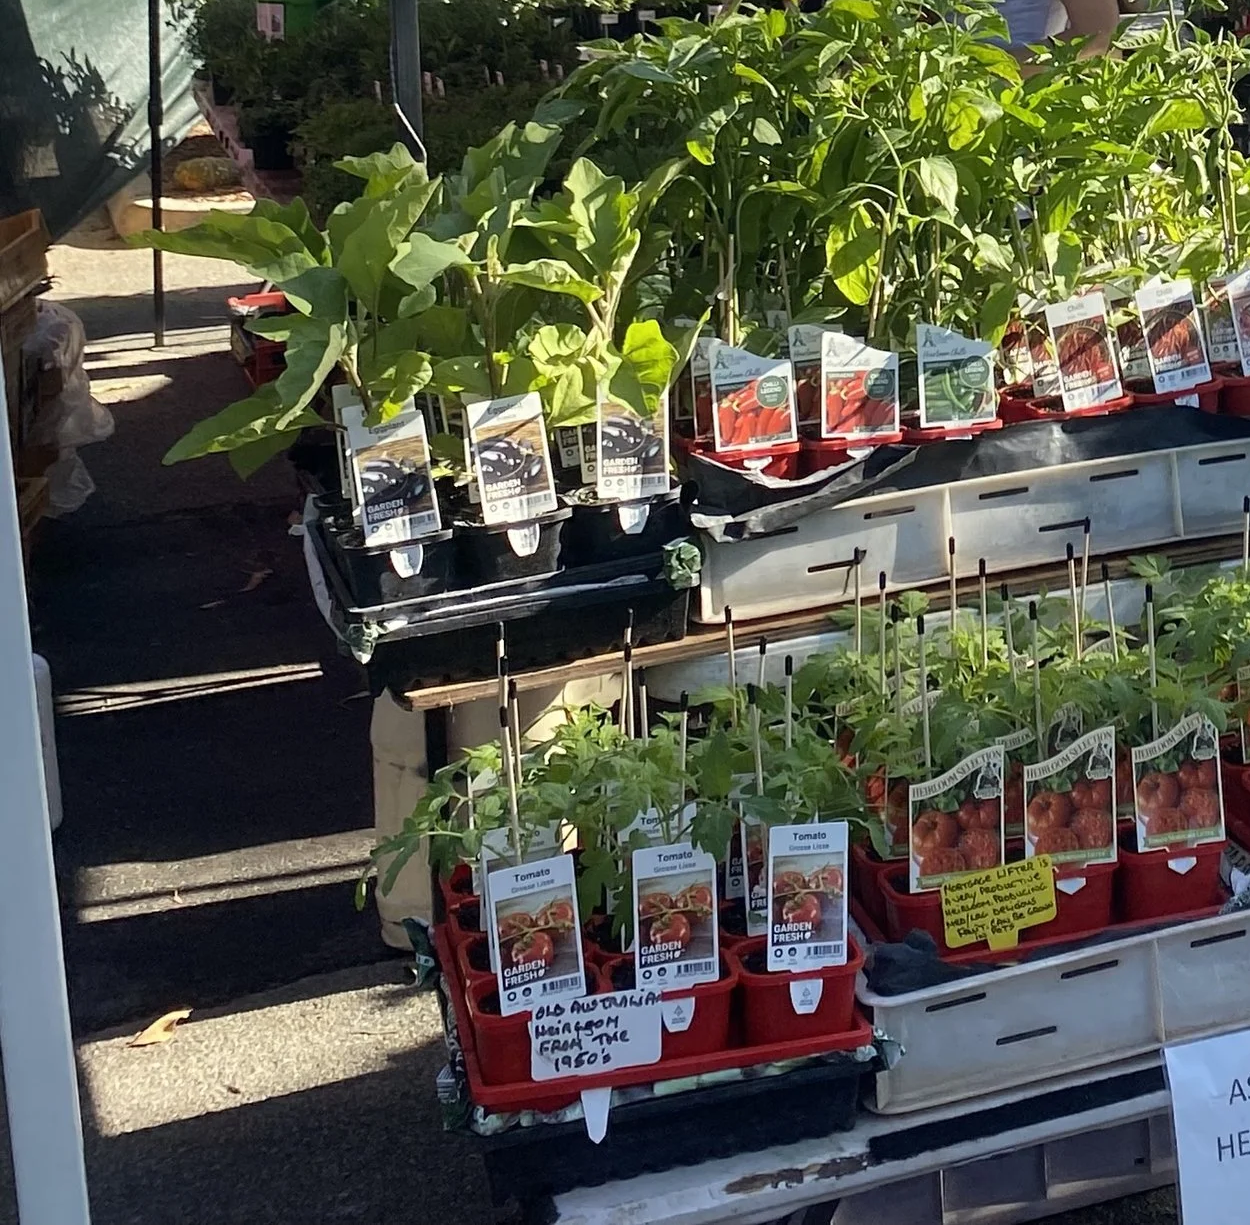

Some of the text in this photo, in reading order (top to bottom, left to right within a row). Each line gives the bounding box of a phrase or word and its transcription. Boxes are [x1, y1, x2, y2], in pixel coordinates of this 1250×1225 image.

[760, 387, 782, 395] LEGEND
[602, 456, 638, 467] GARDEN
[485, 478, 521, 492] GARDEN
[367, 499, 403, 515] GARDEN
[367, 509, 398, 523] FRESH
[1135, 734, 1177, 760] HEIRLOOM
[1027, 730, 1113, 779] HEIRLOOM SELECTION
[912, 749, 1001, 798] HEIRLOOM SELECTION
[793, 831, 827, 842] Tomato
[812, 843, 830, 851] Lisse
[657, 851, 693, 863] Tomato
[678, 862, 697, 870] Lisse
[513, 868, 551, 883] Tomato
[943, 875, 992, 895] MORTGAGE
[996, 862, 1034, 879] LIFTER
[944, 897, 951, 906] A
[979, 873, 1041, 895] PRODUCTIVE
[773, 922, 813, 934] GARDEN
[991, 923, 1015, 935] POTS
[773, 932, 805, 944] FRESH
[641, 940, 682, 955] GARDEN
[641, 952, 674, 965] FRESH
[504, 959, 545, 977] GARDEN
[504, 970, 538, 987] FRESH
[535, 1004, 565, 1020] OLD
[540, 1037, 582, 1056] FROM
